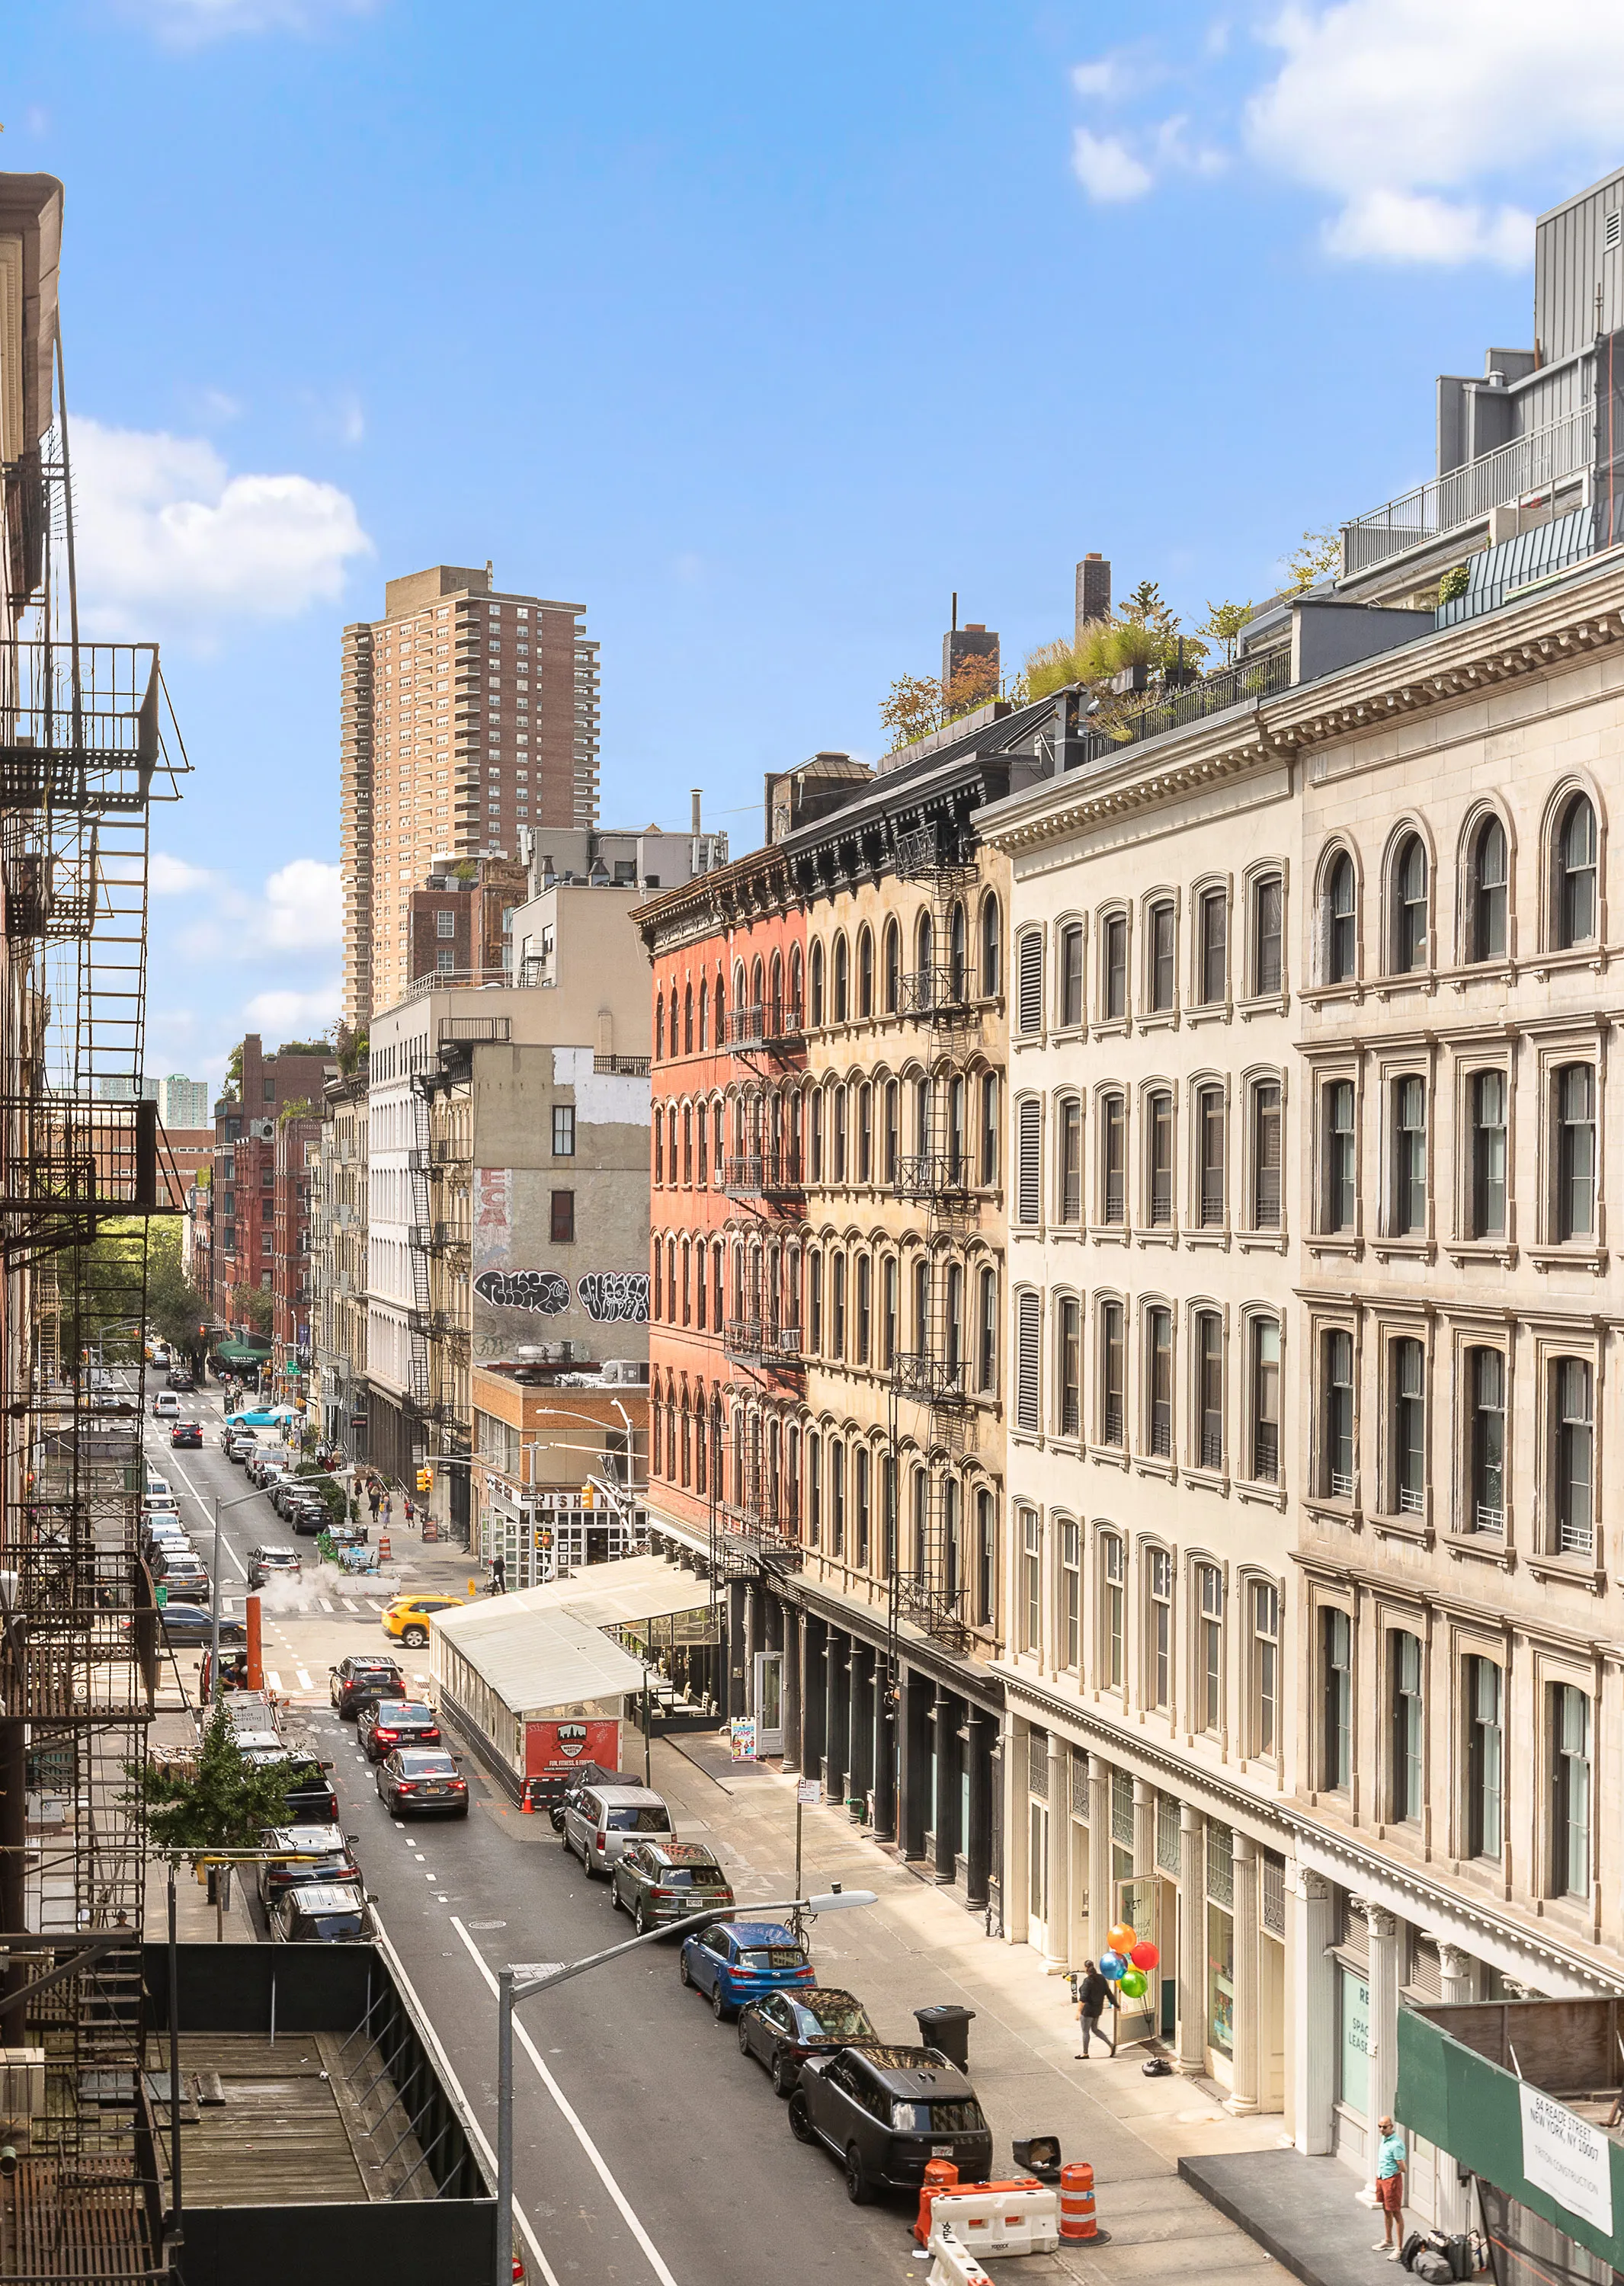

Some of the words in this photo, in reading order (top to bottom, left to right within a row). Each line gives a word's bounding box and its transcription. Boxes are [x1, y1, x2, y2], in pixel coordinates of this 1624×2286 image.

[1360, 1987, 1369, 2005] RE
[1353, 2018, 1369, 2038] SPAC
[1530, 2108, 1546, 2128] NEW
[1546, 2118, 1565, 2144] YORK,
[1568, 2132, 1577, 2150] NY
[1578, 2139, 1599, 2162] 10007
[1536, 2098, 1544, 2112] 64
[1545, 2103, 1567, 2127] READE
[1568, 2117, 1591, 2142] STREET
[1552, 2158, 1599, 2195] CONSTRUCTION
